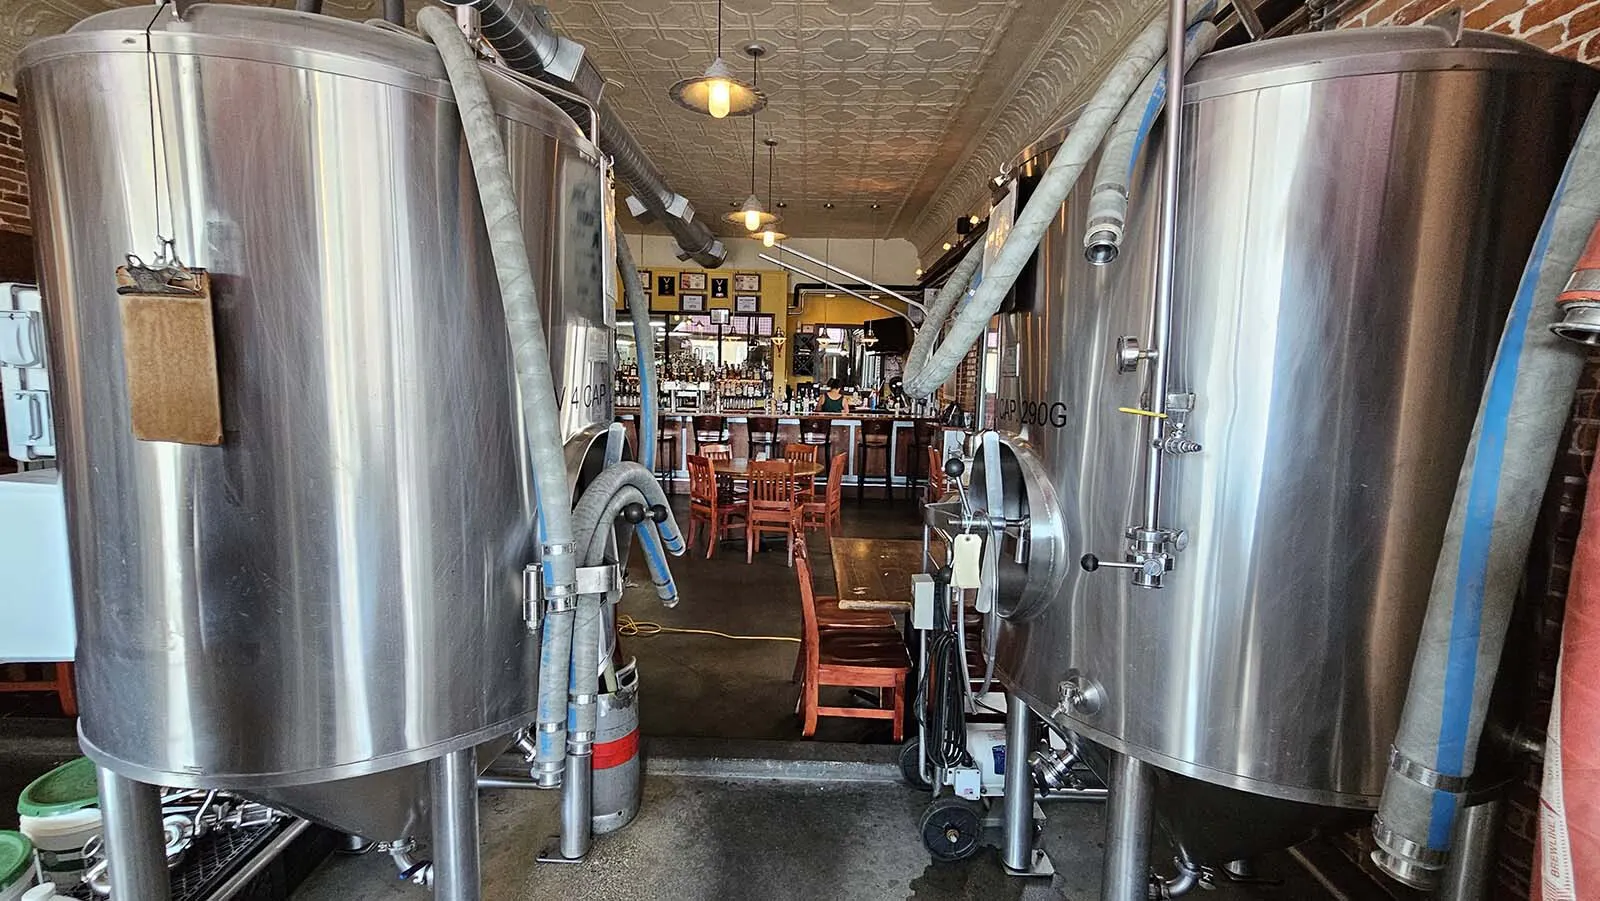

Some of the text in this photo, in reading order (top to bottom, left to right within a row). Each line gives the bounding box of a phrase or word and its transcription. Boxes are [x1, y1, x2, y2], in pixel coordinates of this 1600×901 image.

[571, 386, 579, 409] 4
[1021, 400, 1067, 428] 290G
[1547, 822, 1560, 878] BREWLINE
